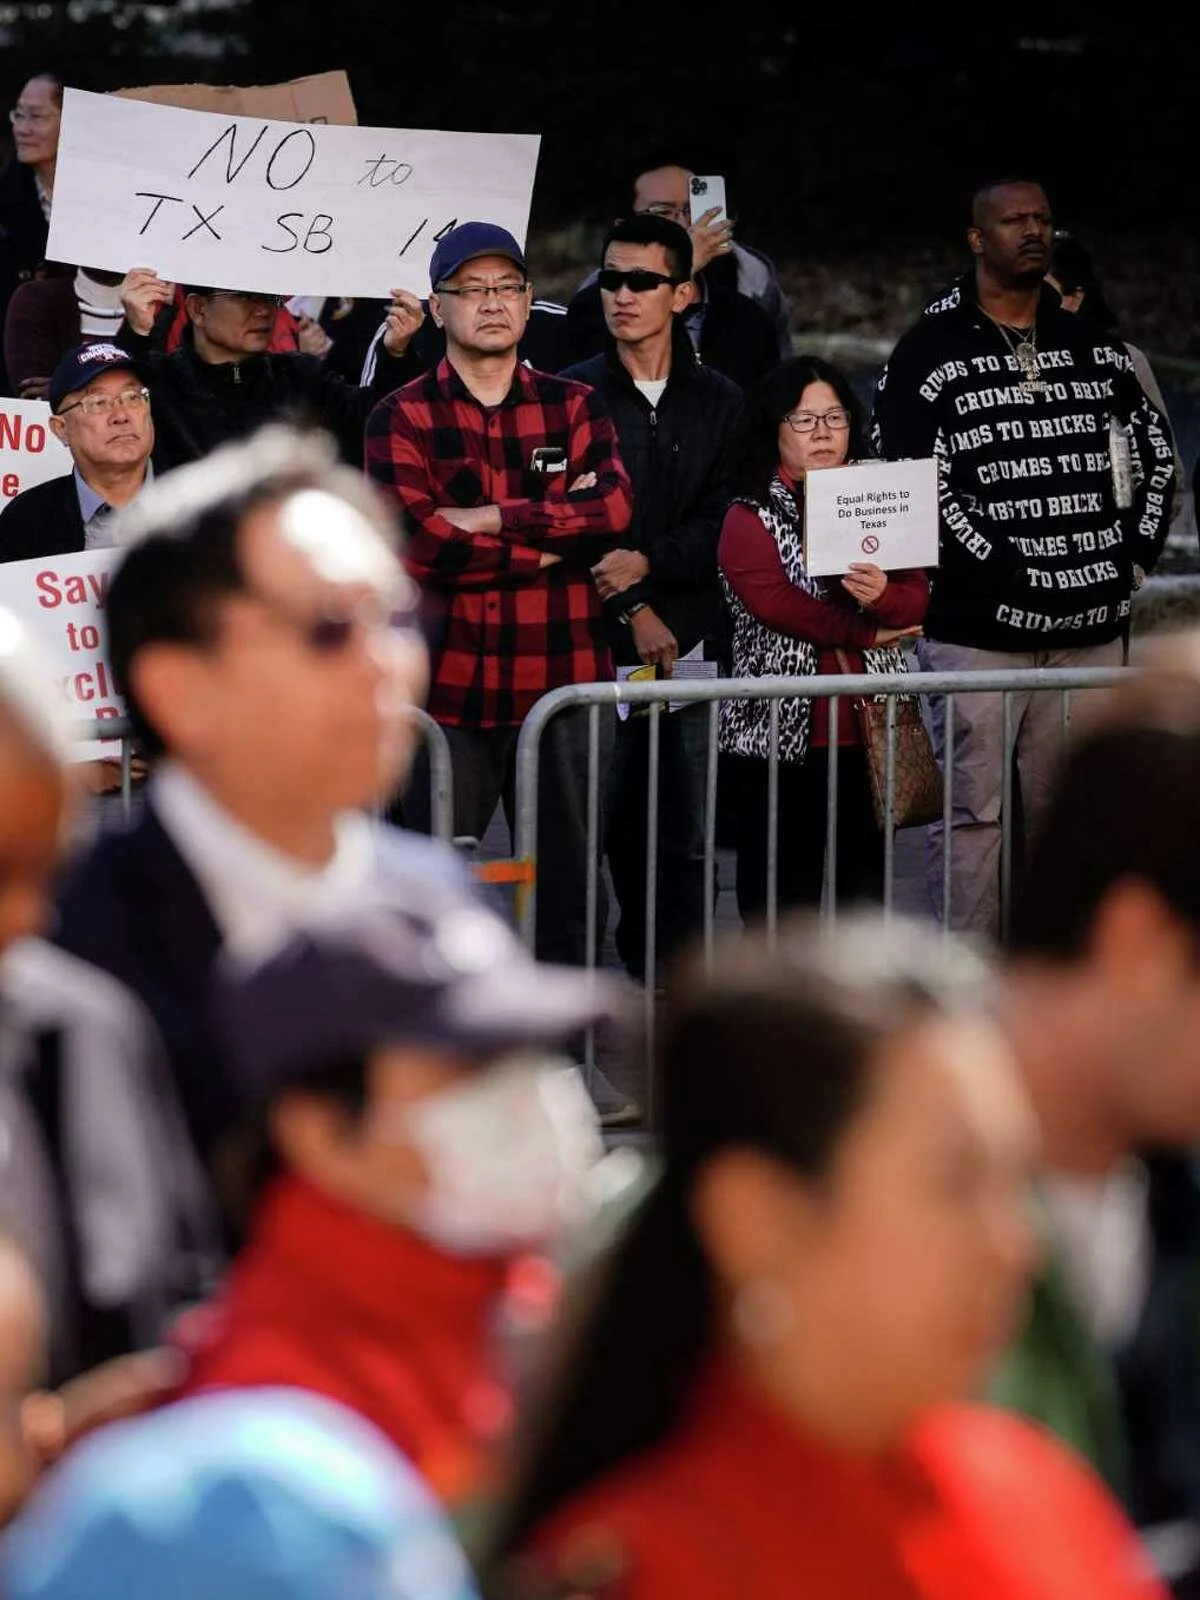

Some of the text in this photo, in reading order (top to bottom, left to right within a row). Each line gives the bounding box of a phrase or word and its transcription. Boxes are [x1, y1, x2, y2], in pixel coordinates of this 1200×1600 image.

[187, 123, 414, 190] NO to
[135, 192, 224, 240] TX
[261, 213, 334, 253] SB
[971, 355, 1000, 374] TO
[955, 386, 1035, 415] CRUMBS
[1045, 383, 1068, 402] TO
[996, 421, 1025, 441] TO
[1028, 414, 1096, 438] BRICKS
[977, 457, 1053, 484] CRUMBS
[1057, 453, 1081, 474] TO
[836, 491, 909, 506] Equal Rights to
[838, 503, 909, 518] Do Business in
[1015, 498, 1042, 519] TO
[860, 520, 887, 529] Texas
[1027, 560, 1119, 589] TO BRICKS
[36, 571, 109, 610] Say
[1087, 606, 1108, 625] TO
[67, 622, 99, 651] to
